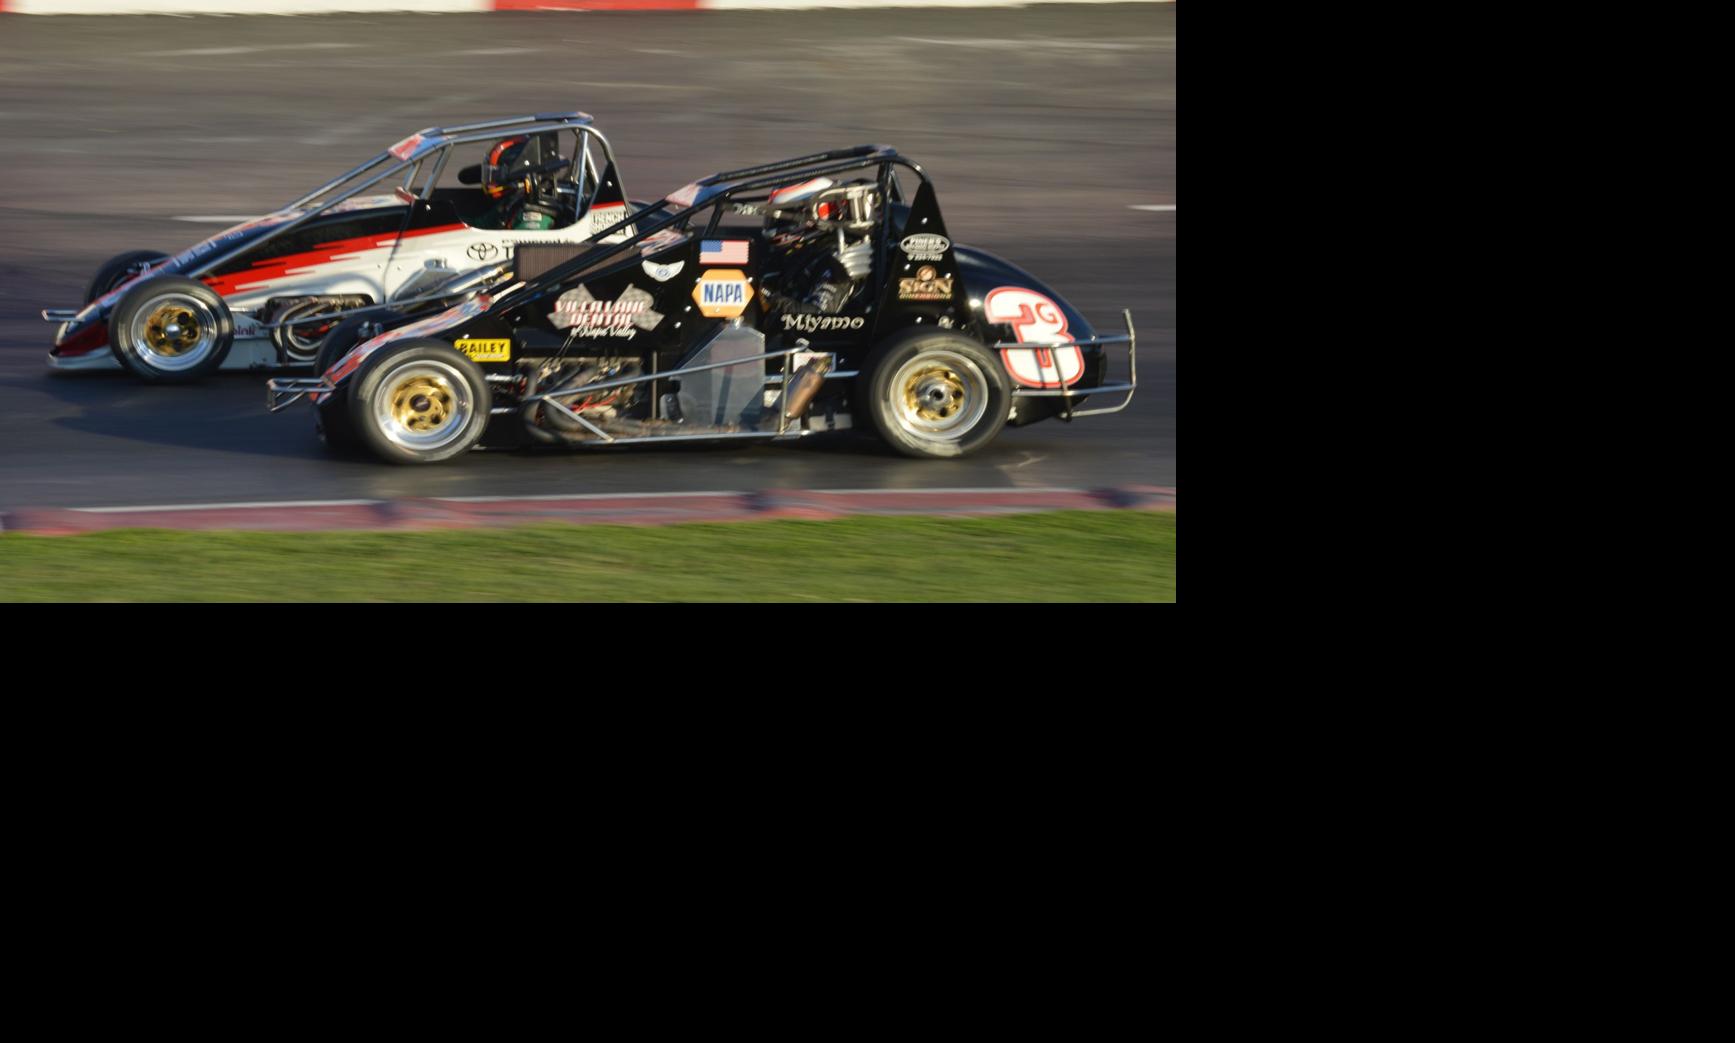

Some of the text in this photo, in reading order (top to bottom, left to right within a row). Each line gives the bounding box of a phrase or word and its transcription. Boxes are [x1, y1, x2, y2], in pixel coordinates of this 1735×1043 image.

[704, 283, 743, 303] NAPA
[898, 278, 953, 294] SIGN
[460, 342, 507, 354] BAILEY
